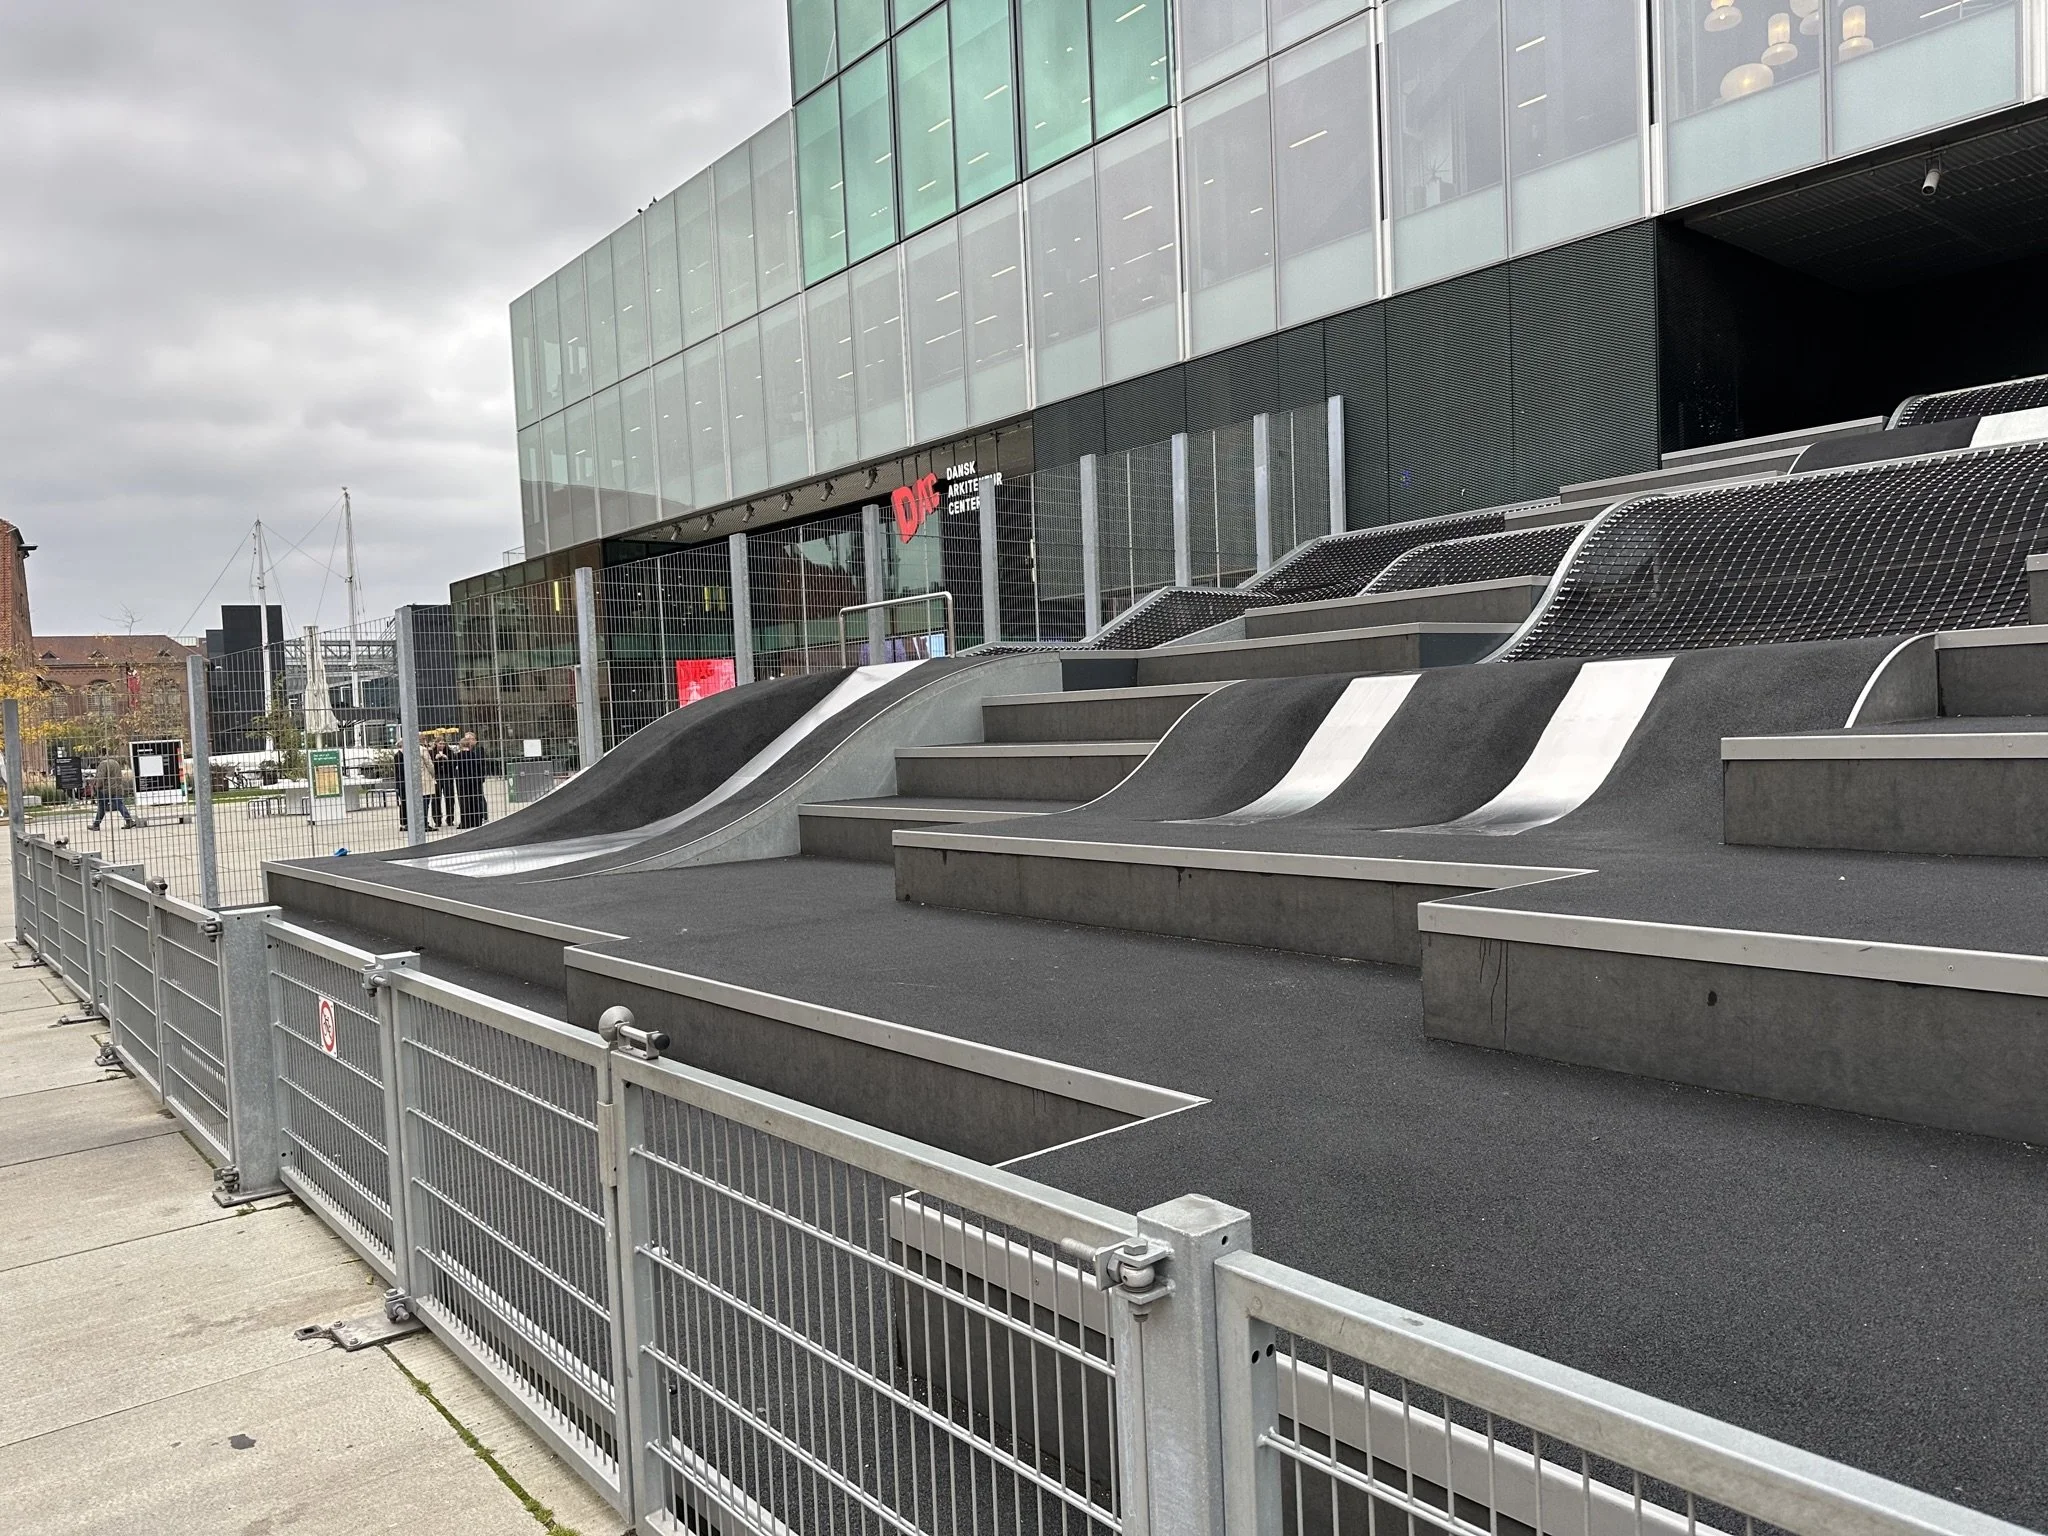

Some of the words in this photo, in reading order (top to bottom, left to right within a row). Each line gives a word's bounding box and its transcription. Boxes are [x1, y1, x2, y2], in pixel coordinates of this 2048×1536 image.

[946, 460, 976, 481] DANSK
[948, 472, 1003, 498] ARKITEUR
[891, 472, 940, 544] DAC
